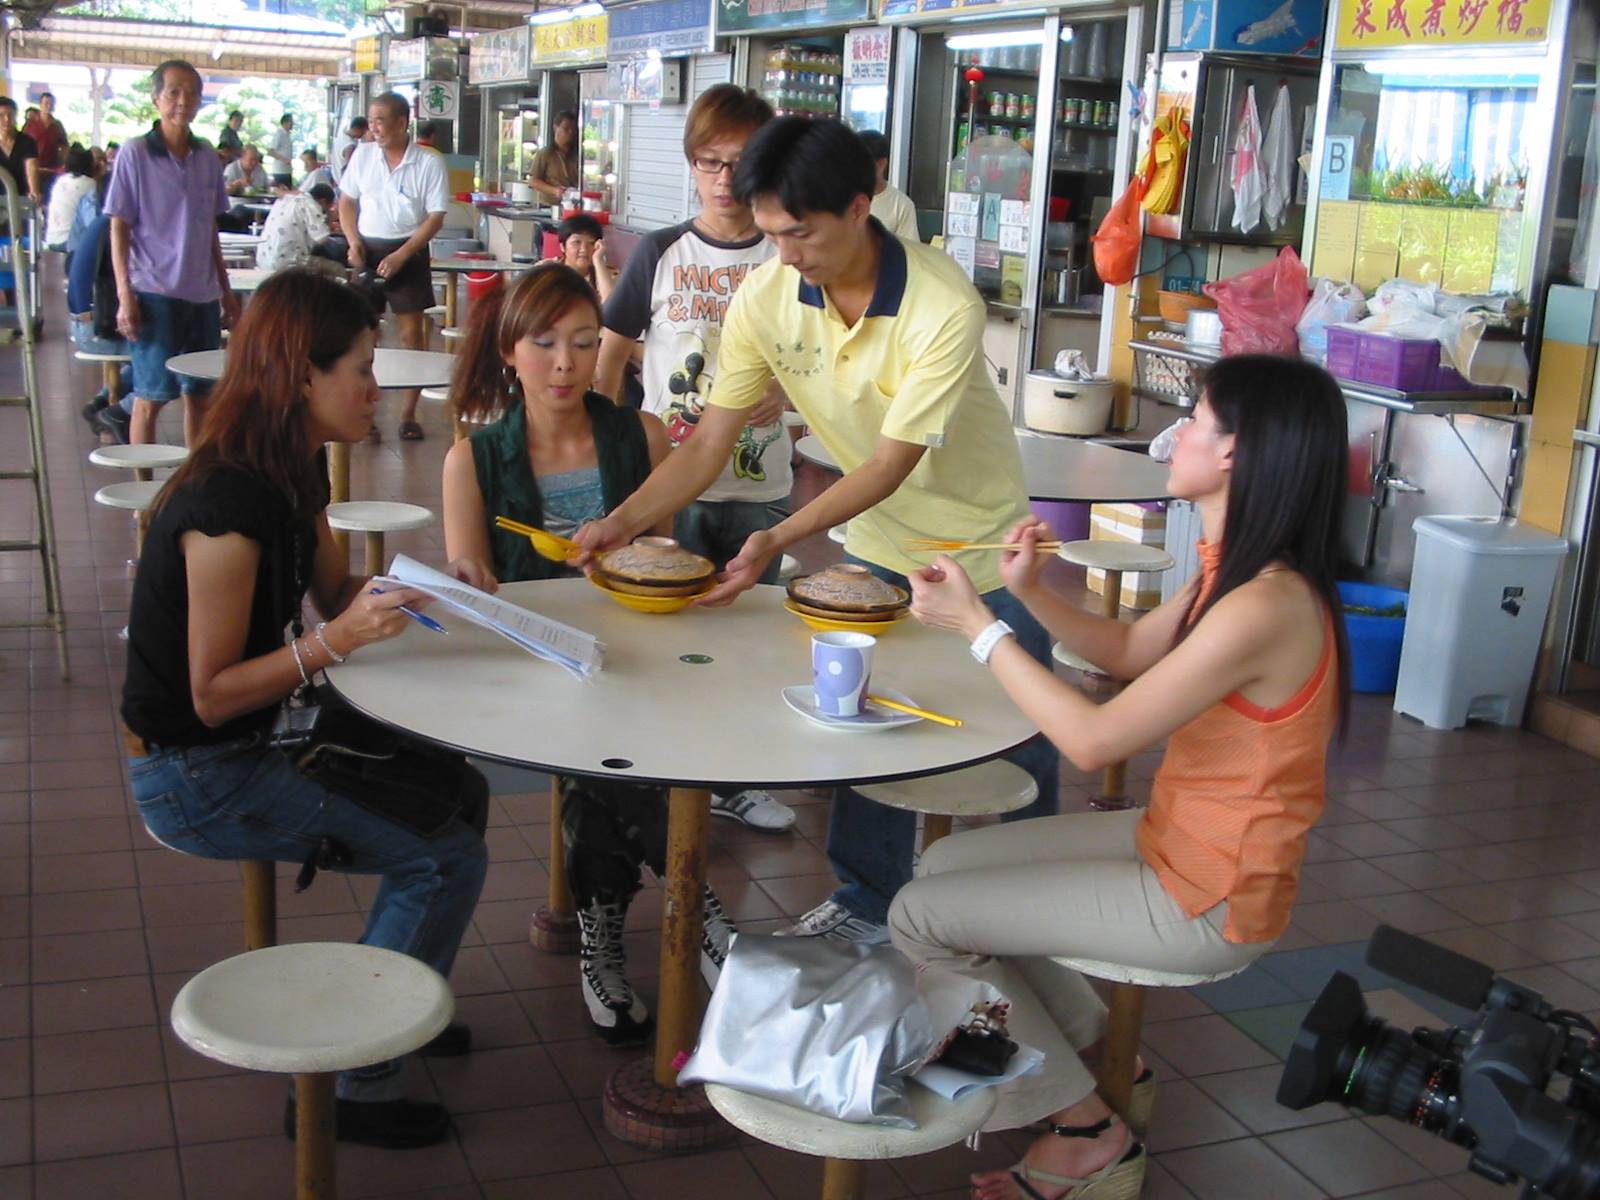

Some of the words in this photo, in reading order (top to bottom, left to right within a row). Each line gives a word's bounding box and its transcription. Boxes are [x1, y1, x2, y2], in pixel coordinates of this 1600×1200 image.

[1329, 142, 1346, 174] B
[986, 199, 997, 221] A
[673, 263, 763, 295] MICK
[690, 294, 733, 327] MI
